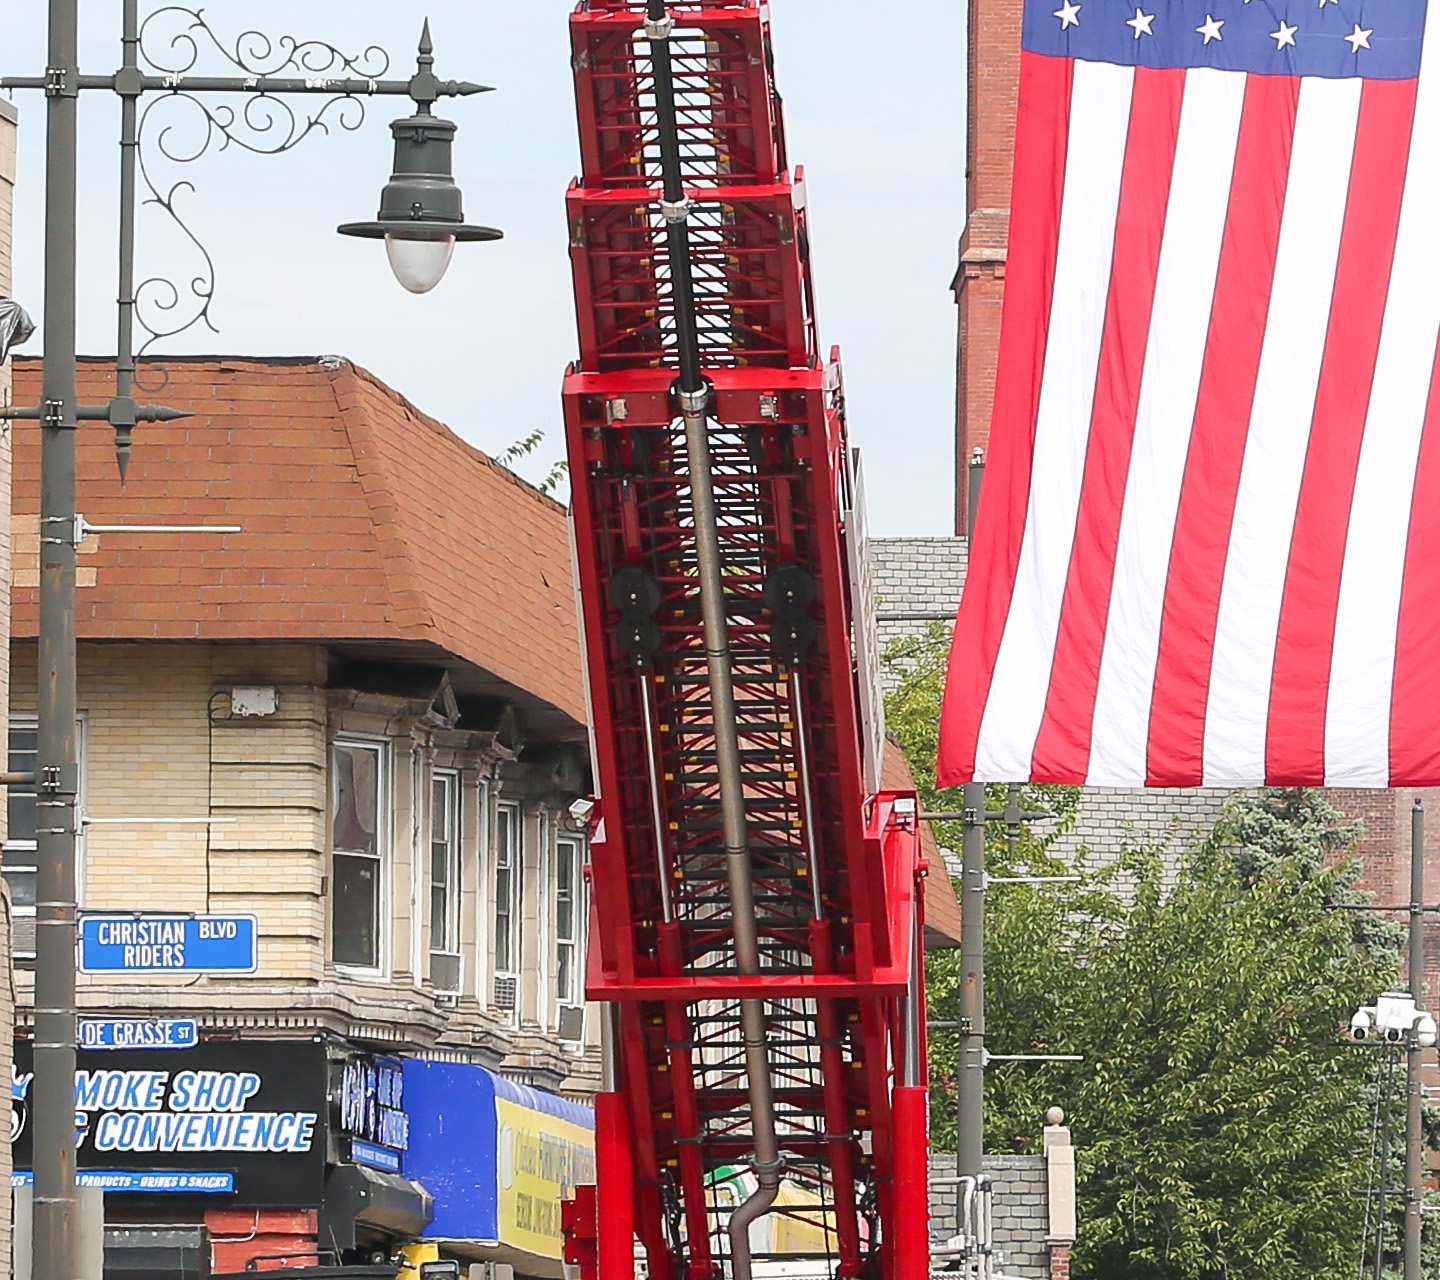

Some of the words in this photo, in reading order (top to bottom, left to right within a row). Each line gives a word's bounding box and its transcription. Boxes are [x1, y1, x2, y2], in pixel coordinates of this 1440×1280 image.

[98, 922, 185, 945] CHRISTIAN
[199, 921, 237, 939] BLVD
[124, 943, 185, 968] RIDERS
[85, 1024, 105, 1045] DE
[113, 1024, 174, 1045] GRASSE
[177, 1026, 190, 1039] ST
[75, 1071, 170, 1111] MOKE
[168, 1071, 261, 1111] SHOP
[94, 1113, 318, 1152] CONVENIENCE
